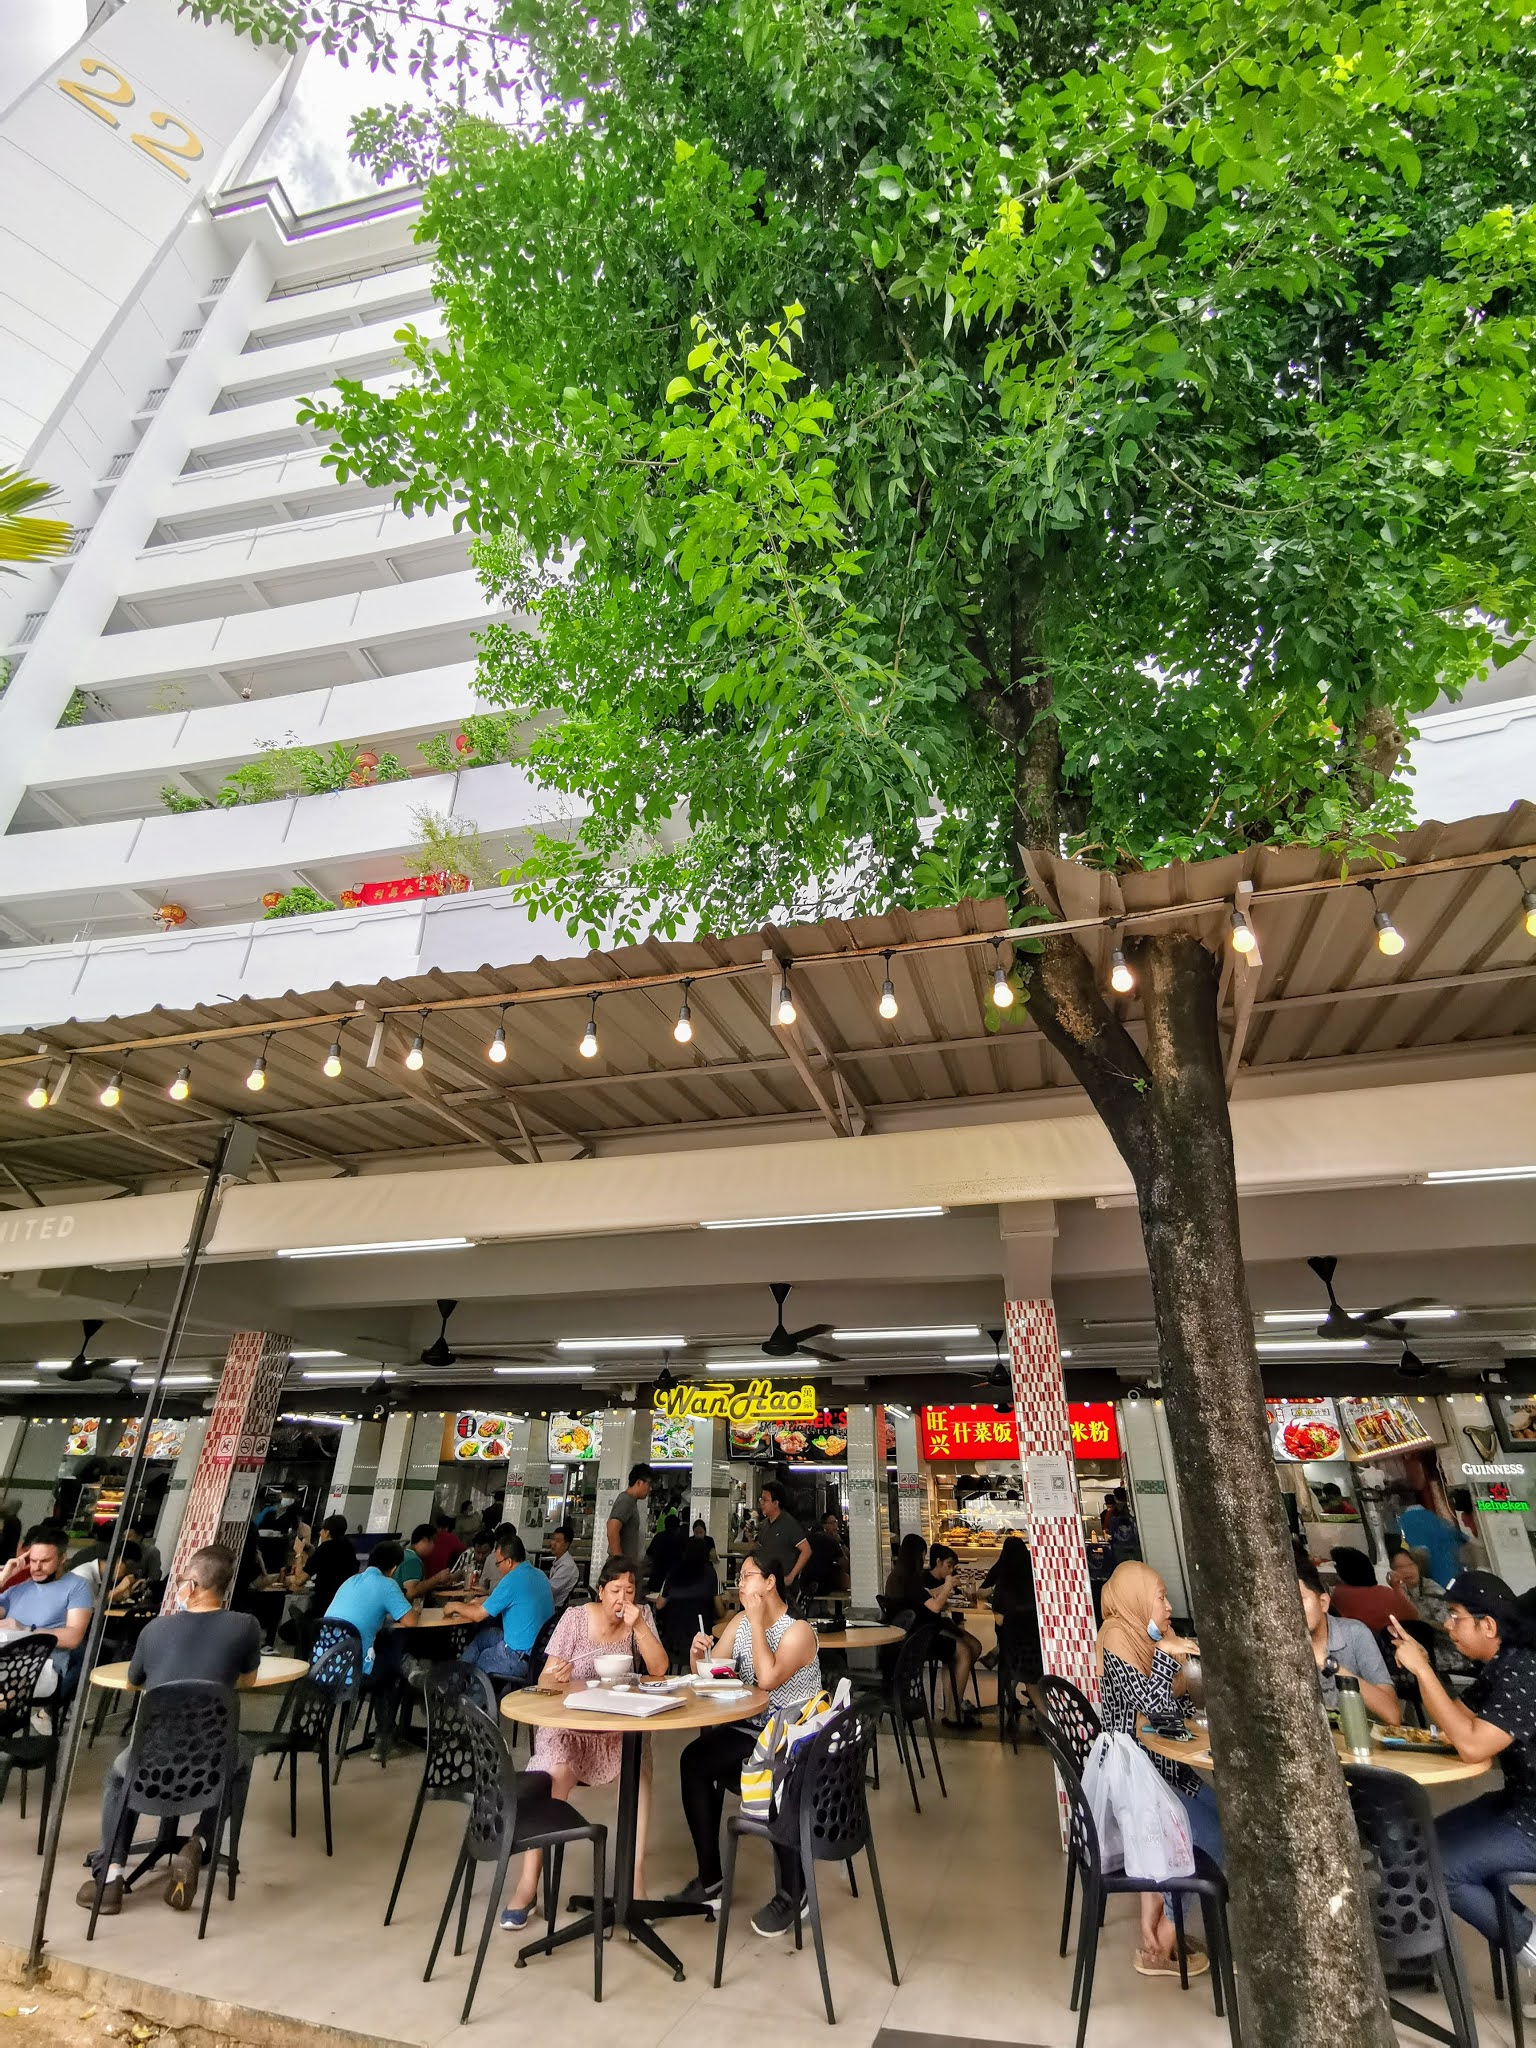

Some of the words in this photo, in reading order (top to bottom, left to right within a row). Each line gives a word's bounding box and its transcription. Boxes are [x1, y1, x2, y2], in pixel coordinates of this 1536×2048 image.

[57, 58, 204, 184] 22
[953, 1421, 1013, 1443] 什菜饭
[1069, 1420, 1110, 1443] 米粉
[1461, 1462, 1525, 1475] GUINNESS
[1476, 1500, 1530, 1511] Heineken
